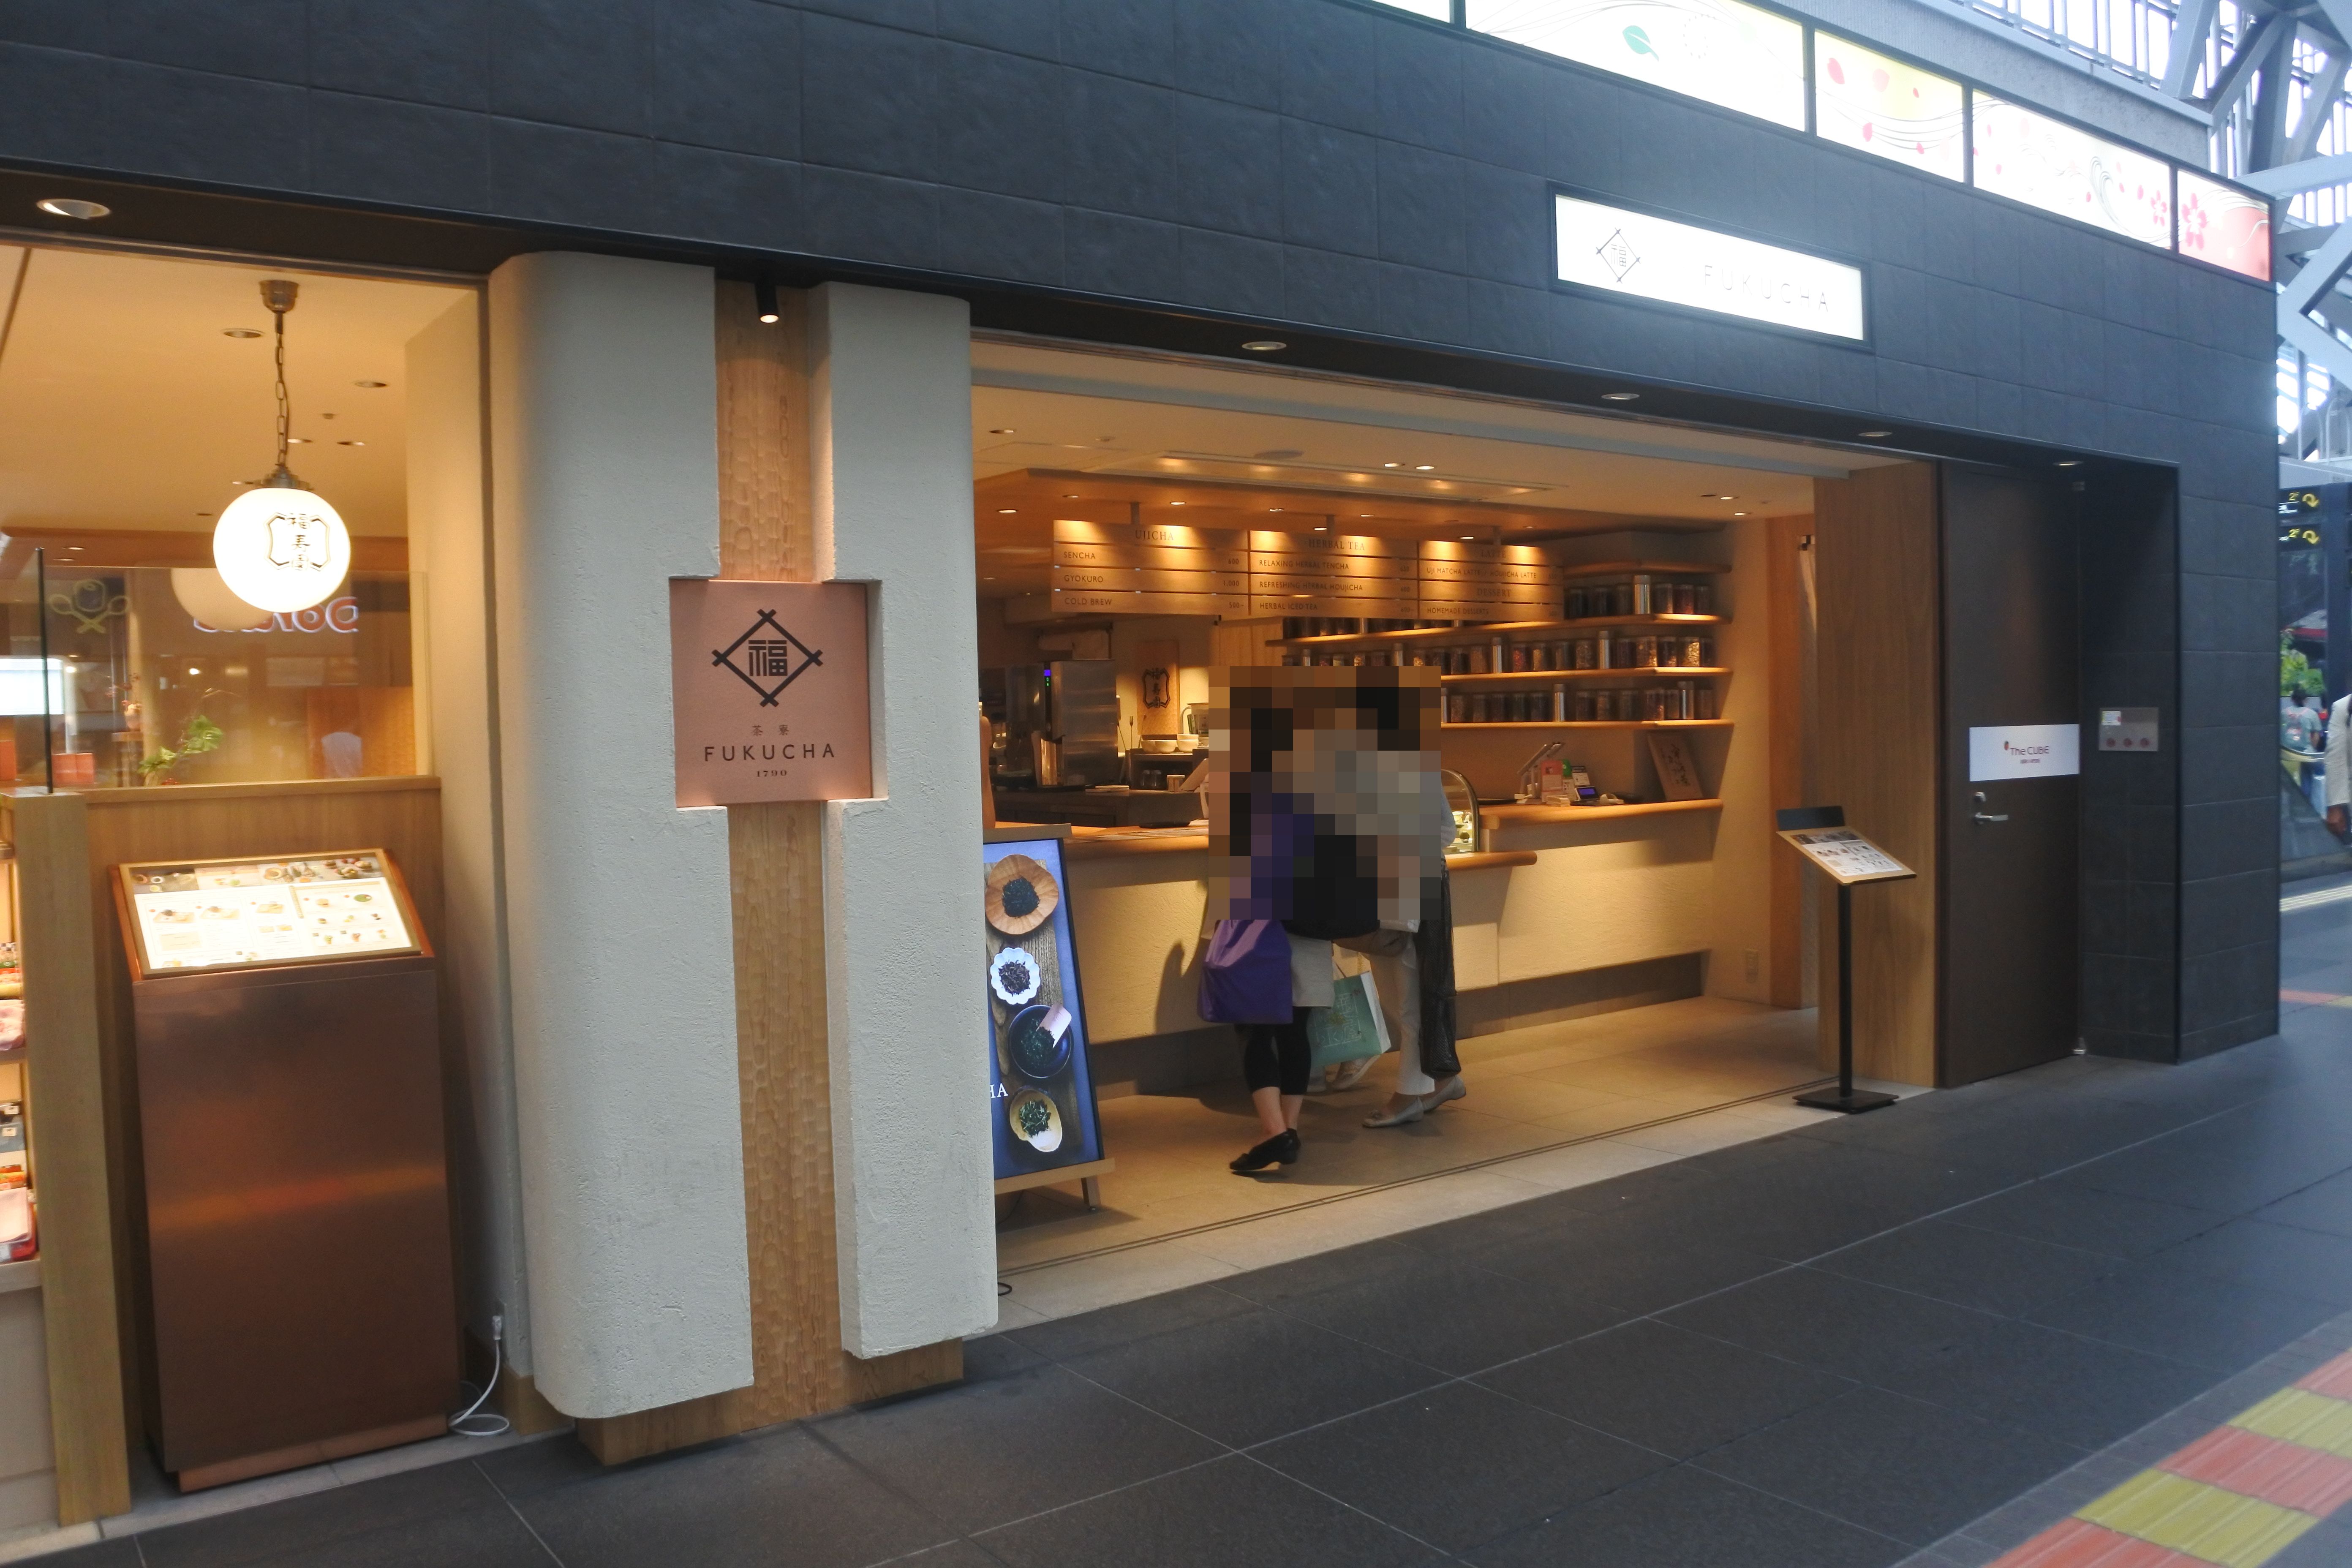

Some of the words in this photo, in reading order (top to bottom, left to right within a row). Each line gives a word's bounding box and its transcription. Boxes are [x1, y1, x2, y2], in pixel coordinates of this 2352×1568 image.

[1610, 243, 1627, 267] 福
[1704, 265, 1829, 313] FUKUCHA
[1135, 530, 1174, 541] UJICHA
[1309, 539, 1345, 550] HERBAL
[1348, 541, 1365, 550] TEA
[1064, 575, 1103, 583] GYOKURO
[1330, 583, 1363, 592] HOUJICHA
[1477, 588, 1512, 597] DESSERT
[748, 640, 788, 676] 福
[705, 743, 835, 761] FUKUCHA
[2027, 746, 2049, 754] CUBE
